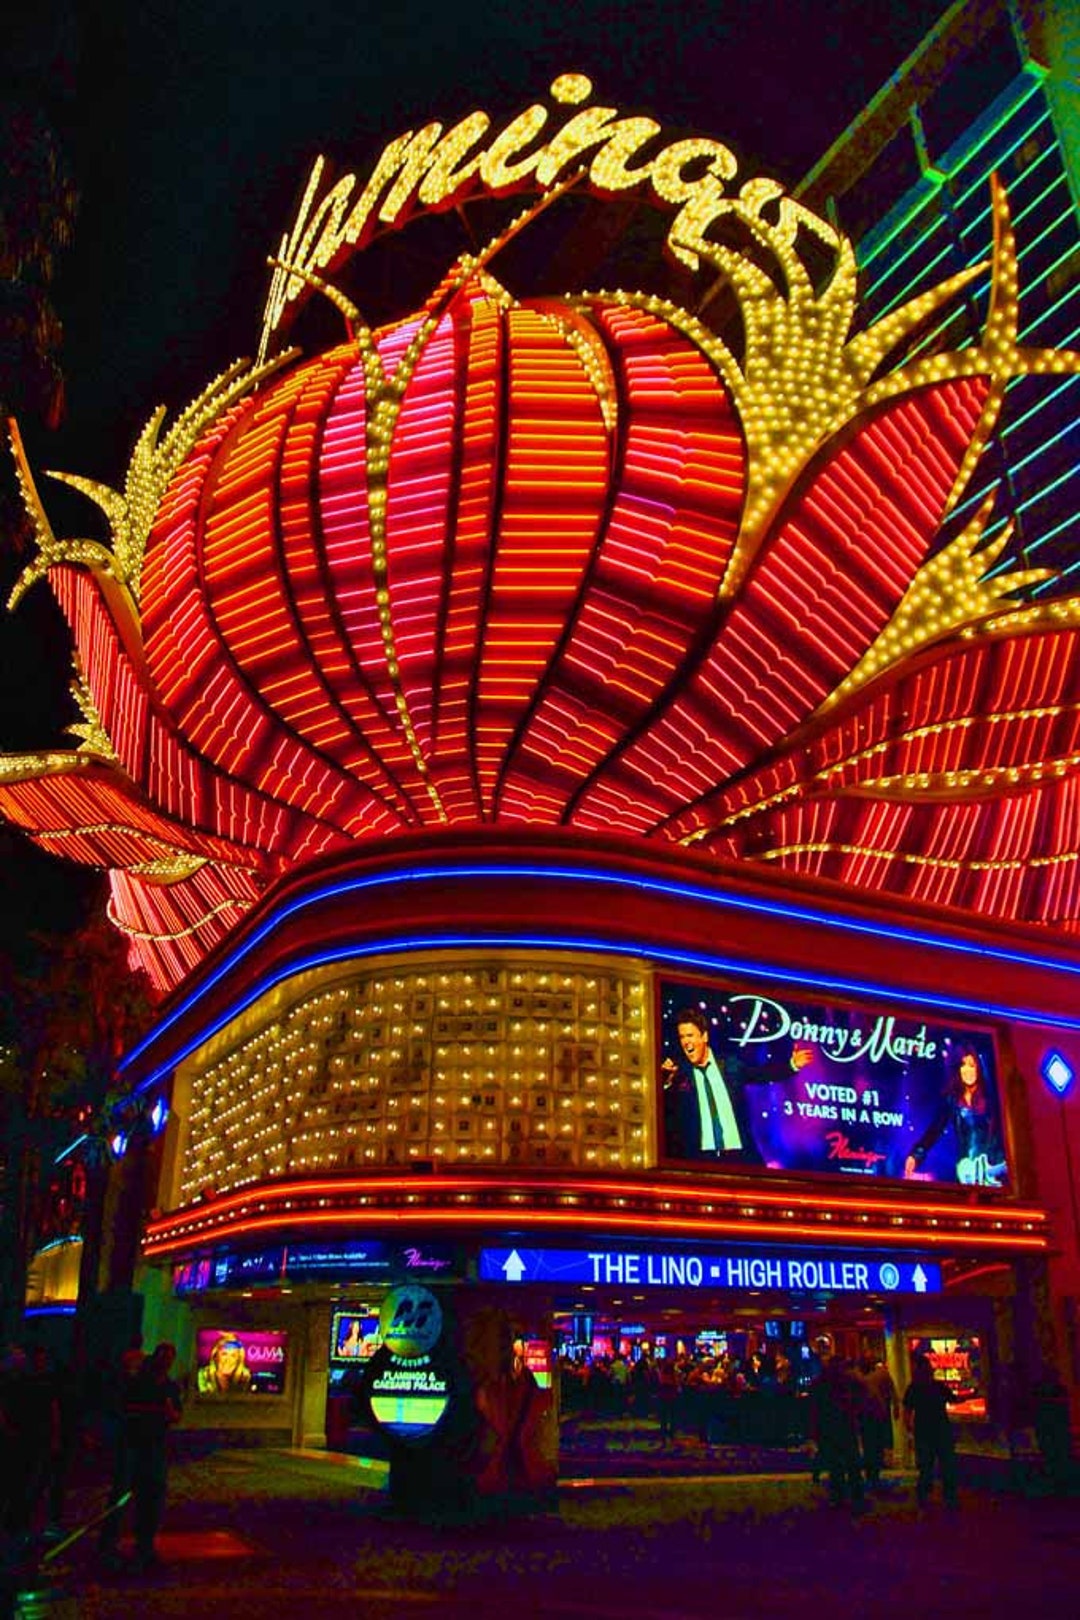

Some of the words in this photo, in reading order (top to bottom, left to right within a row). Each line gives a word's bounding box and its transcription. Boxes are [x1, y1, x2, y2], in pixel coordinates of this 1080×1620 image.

[729, 995, 848, 1057] Donny
[821, 1016, 936, 1064] Marie
[850, 1028, 861, 1047] &
[805, 1082, 857, 1104] VOTED
[862, 1090, 879, 1107] #1
[784, 1101, 793, 1116] 3
[797, 1103, 838, 1120] YEARS
[841, 1108, 856, 1122] IN
[859, 1110, 870, 1123] A
[873, 1111, 903, 1127] ROW
[588, 1253, 640, 1284] THE
[647, 1255, 703, 1286] LINQ
[727, 1258, 782, 1288] HIGH
[788, 1261, 868, 1290] ROLLER
